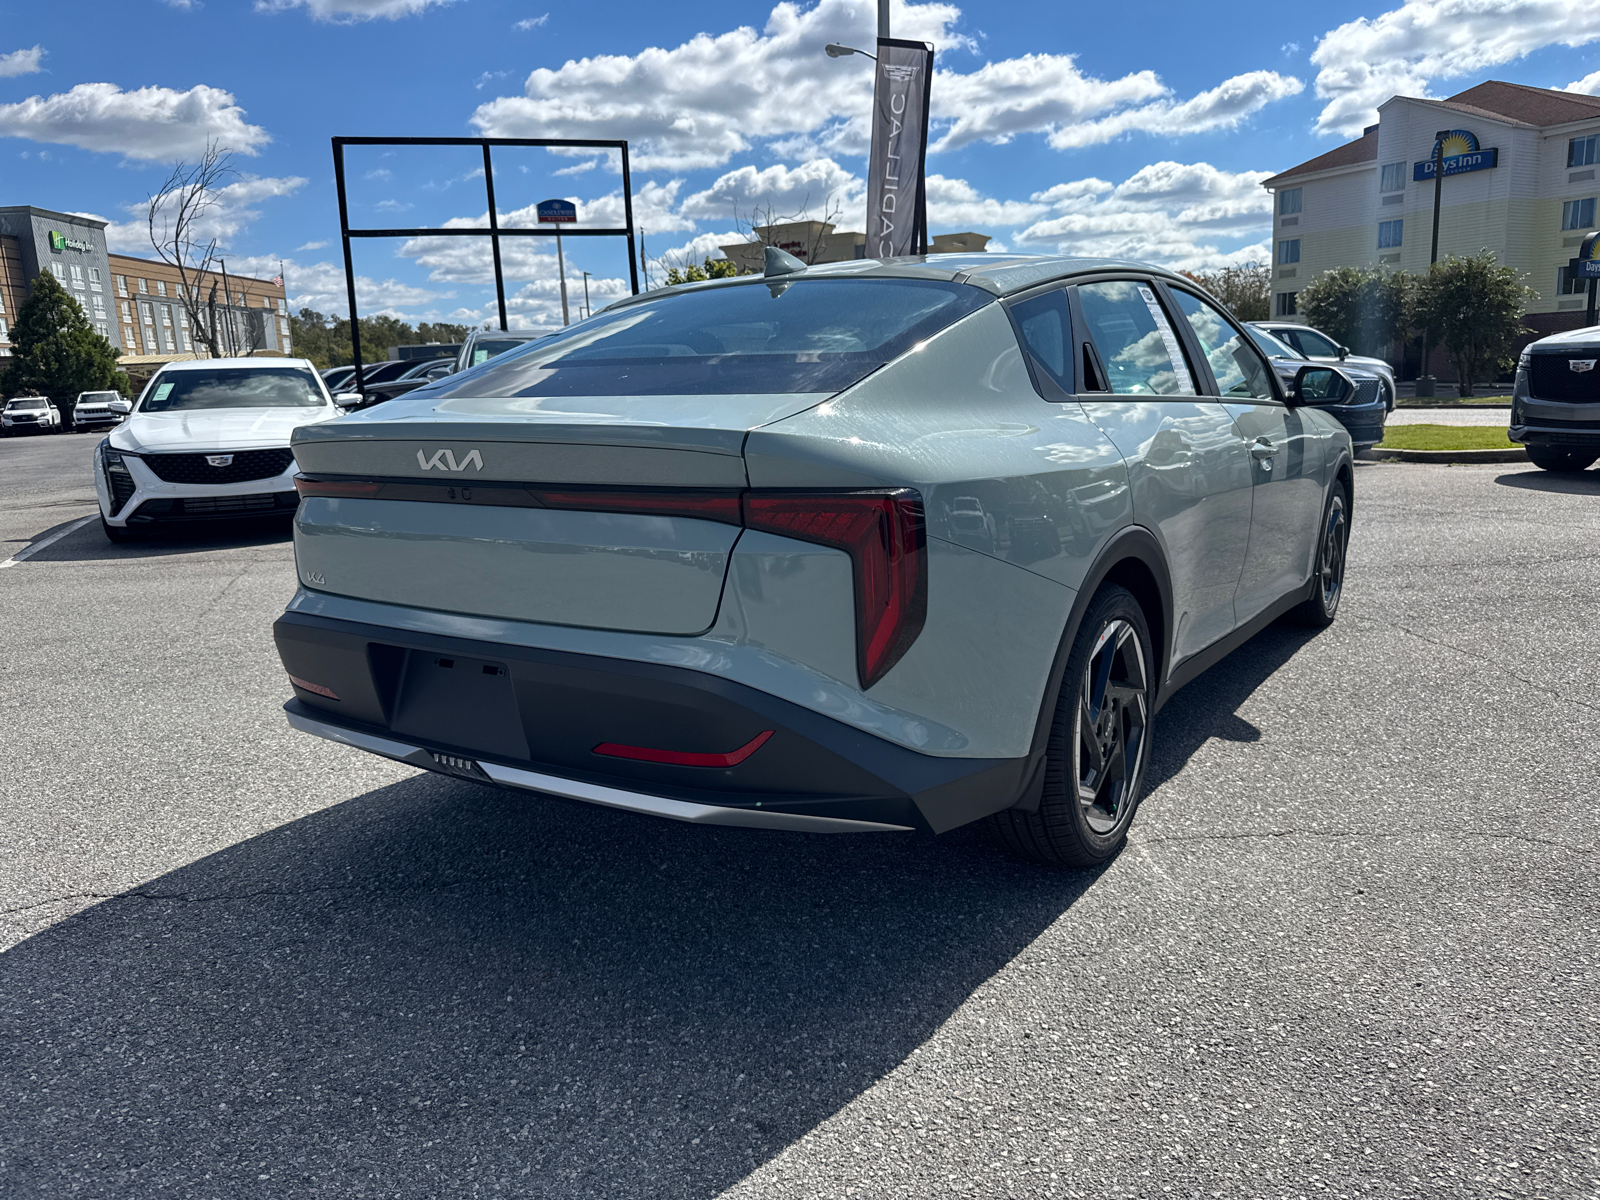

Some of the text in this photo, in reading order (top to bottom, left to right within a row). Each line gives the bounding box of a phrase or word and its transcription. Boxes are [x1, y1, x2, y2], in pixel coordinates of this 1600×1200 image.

[1458, 154, 1482, 167] Inn
[65, 237, 86, 251] Holiday
[417, 449, 484, 471] KIA
[306, 571, 326, 585] K4
